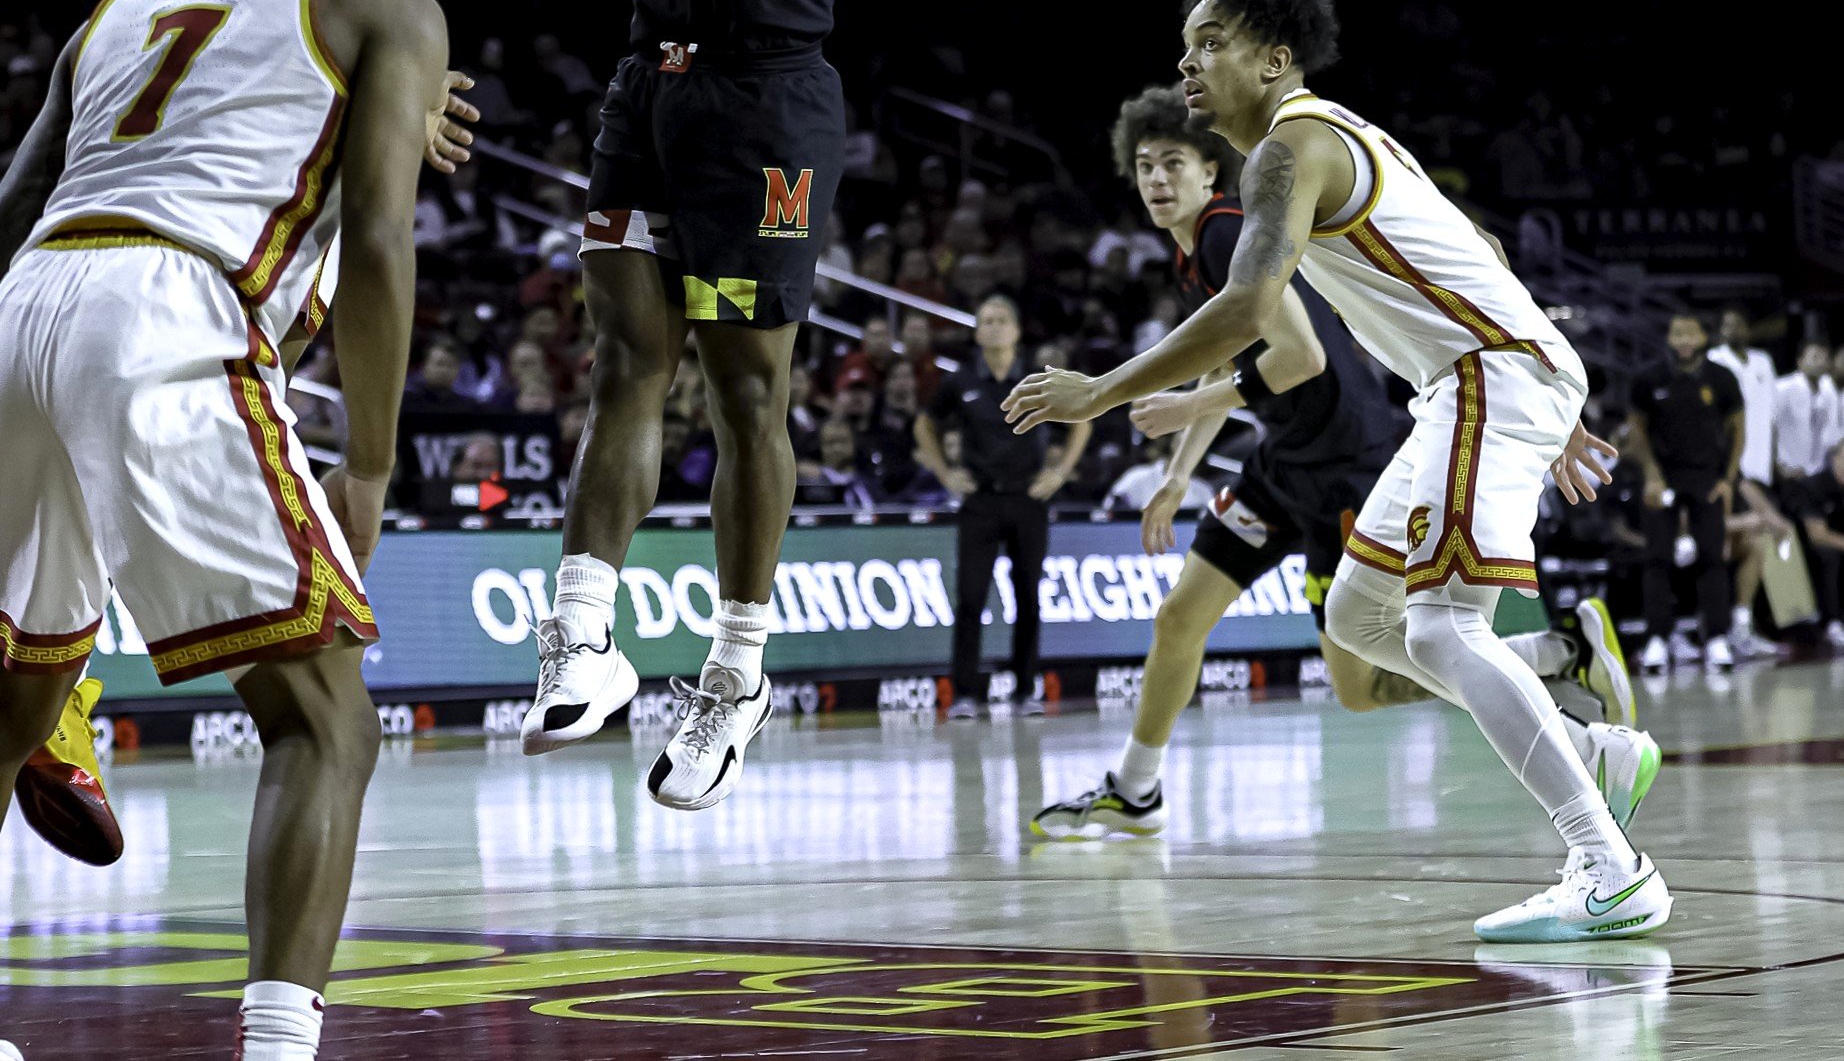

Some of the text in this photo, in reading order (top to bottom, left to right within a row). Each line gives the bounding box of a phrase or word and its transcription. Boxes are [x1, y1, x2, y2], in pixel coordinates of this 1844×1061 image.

[110, 3, 234, 144] 7
[759, 167, 814, 230] M
[413, 434, 552, 481] WLS
[619, 558, 956, 639] DOINION
